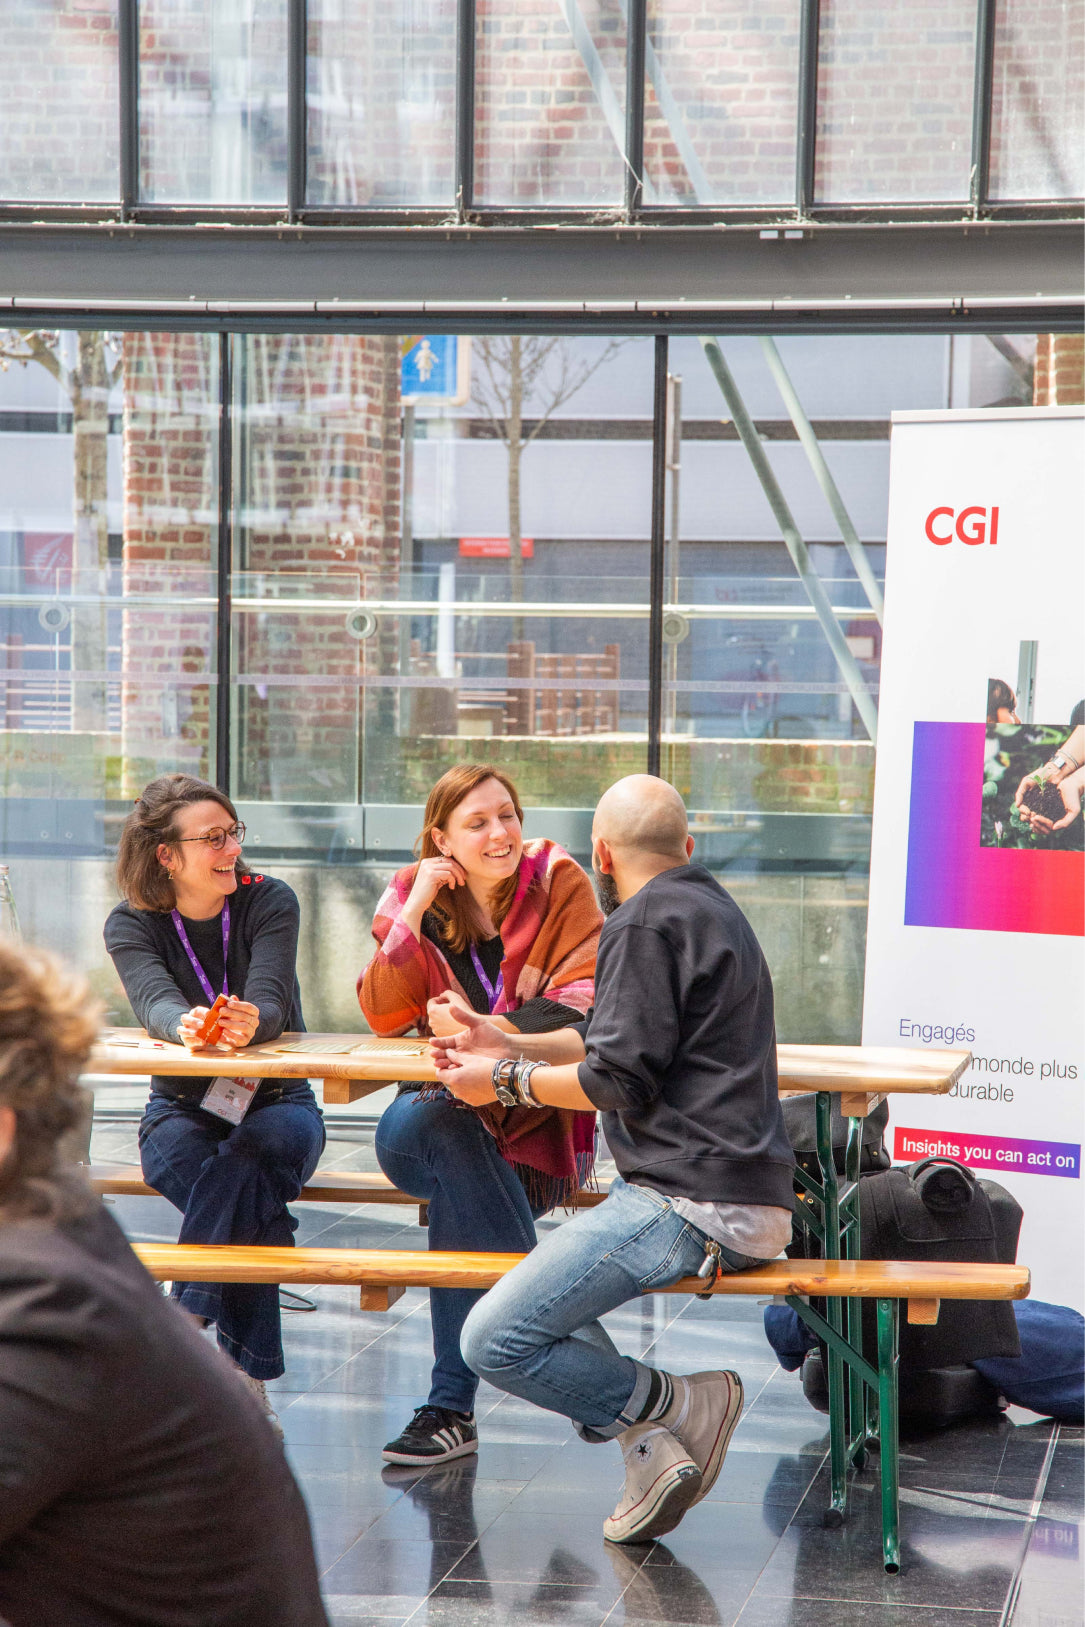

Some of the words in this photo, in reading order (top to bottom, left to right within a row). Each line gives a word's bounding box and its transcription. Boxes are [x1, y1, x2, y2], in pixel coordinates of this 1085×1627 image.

[925, 506, 999, 546] CGI
[899, 1018, 976, 1045] Engagés
[971, 1056, 1034, 1076] monde
[1040, 1059, 1078, 1080] plus
[902, 1136, 961, 1157] Insights
[964, 1147, 991, 1161] you
[995, 1149, 1023, 1163] can
[1027, 1151, 1051, 1166] act
[1055, 1154, 1075, 1169] on
